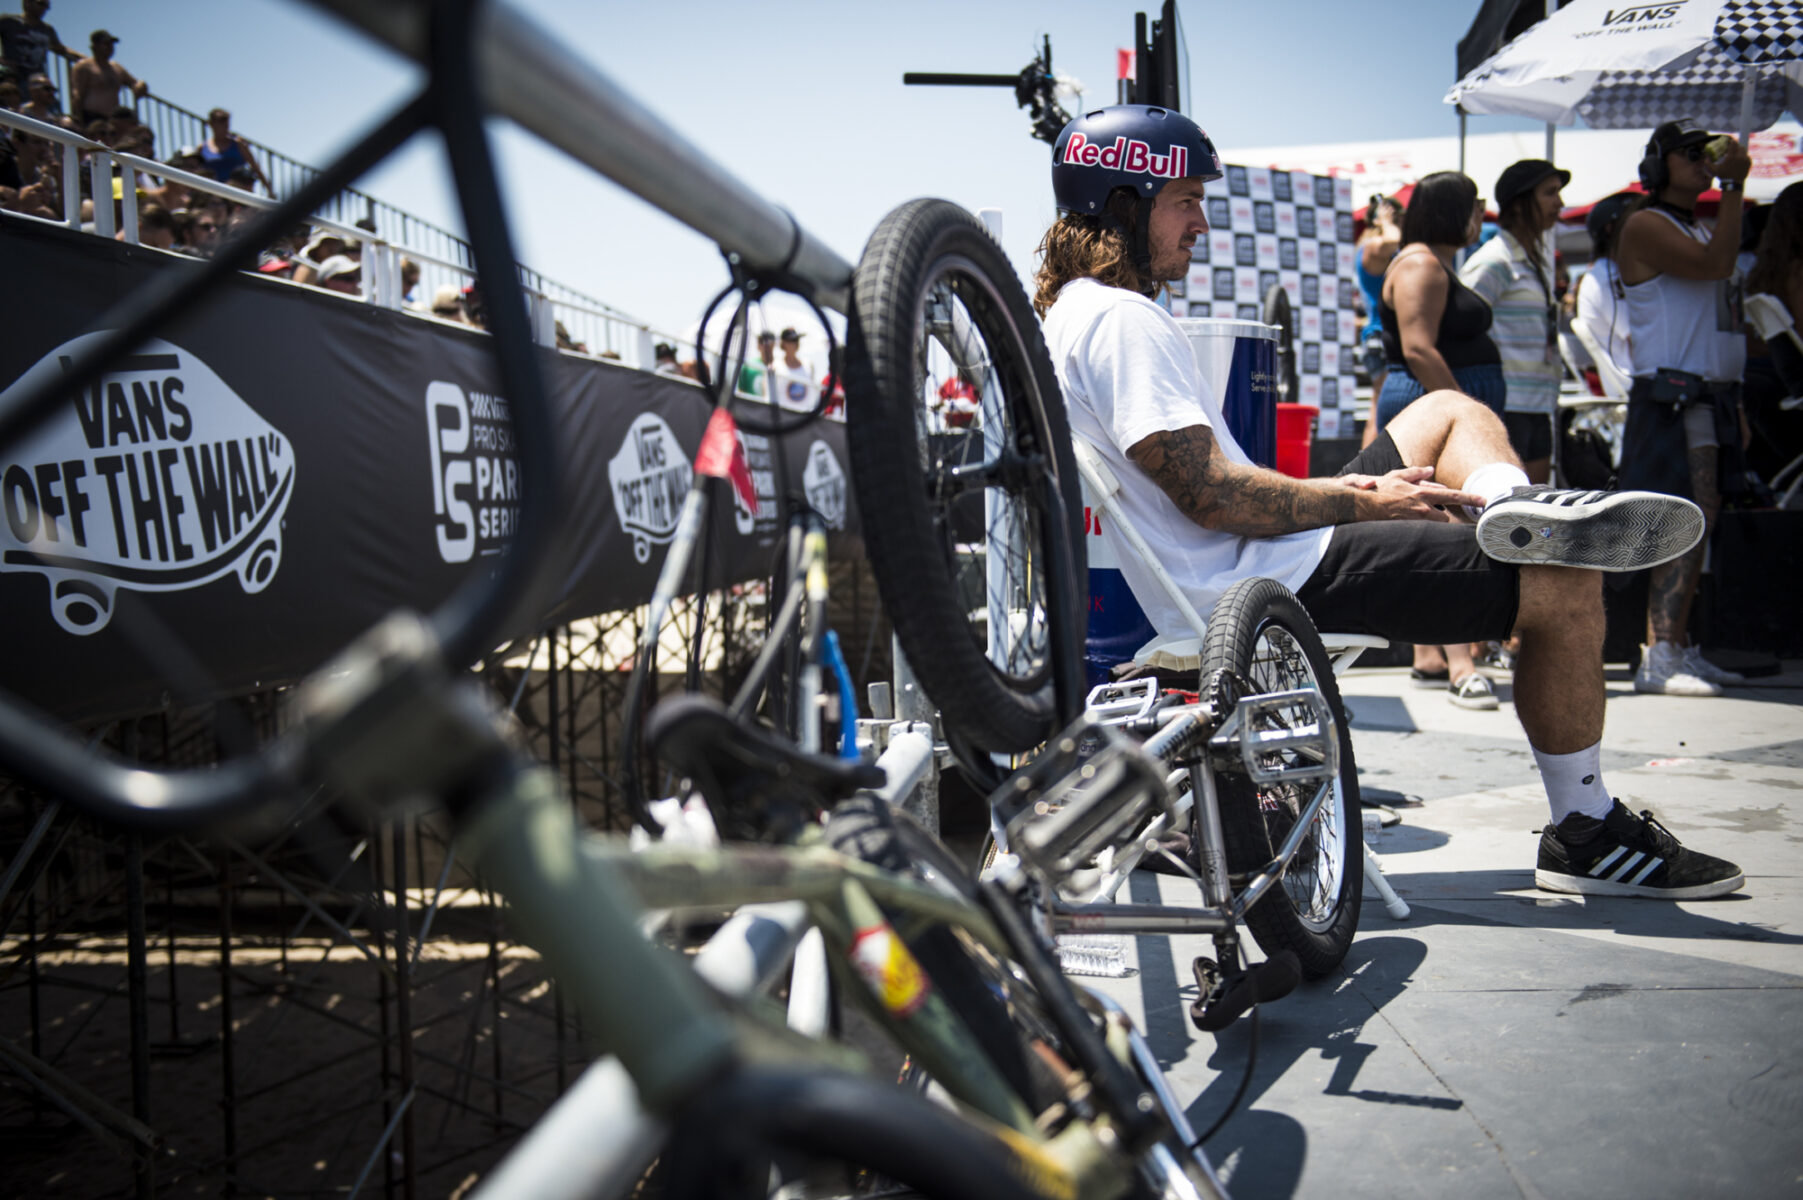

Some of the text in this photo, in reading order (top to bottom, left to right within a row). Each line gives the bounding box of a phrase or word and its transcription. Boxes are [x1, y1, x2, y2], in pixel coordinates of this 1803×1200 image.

[1602, 1, 1688, 26] VANS
[59, 354, 192, 449] VANS
[0, 459, 90, 547] OFF
[94, 448, 194, 562] THE
[476, 456, 522, 500] PAR
